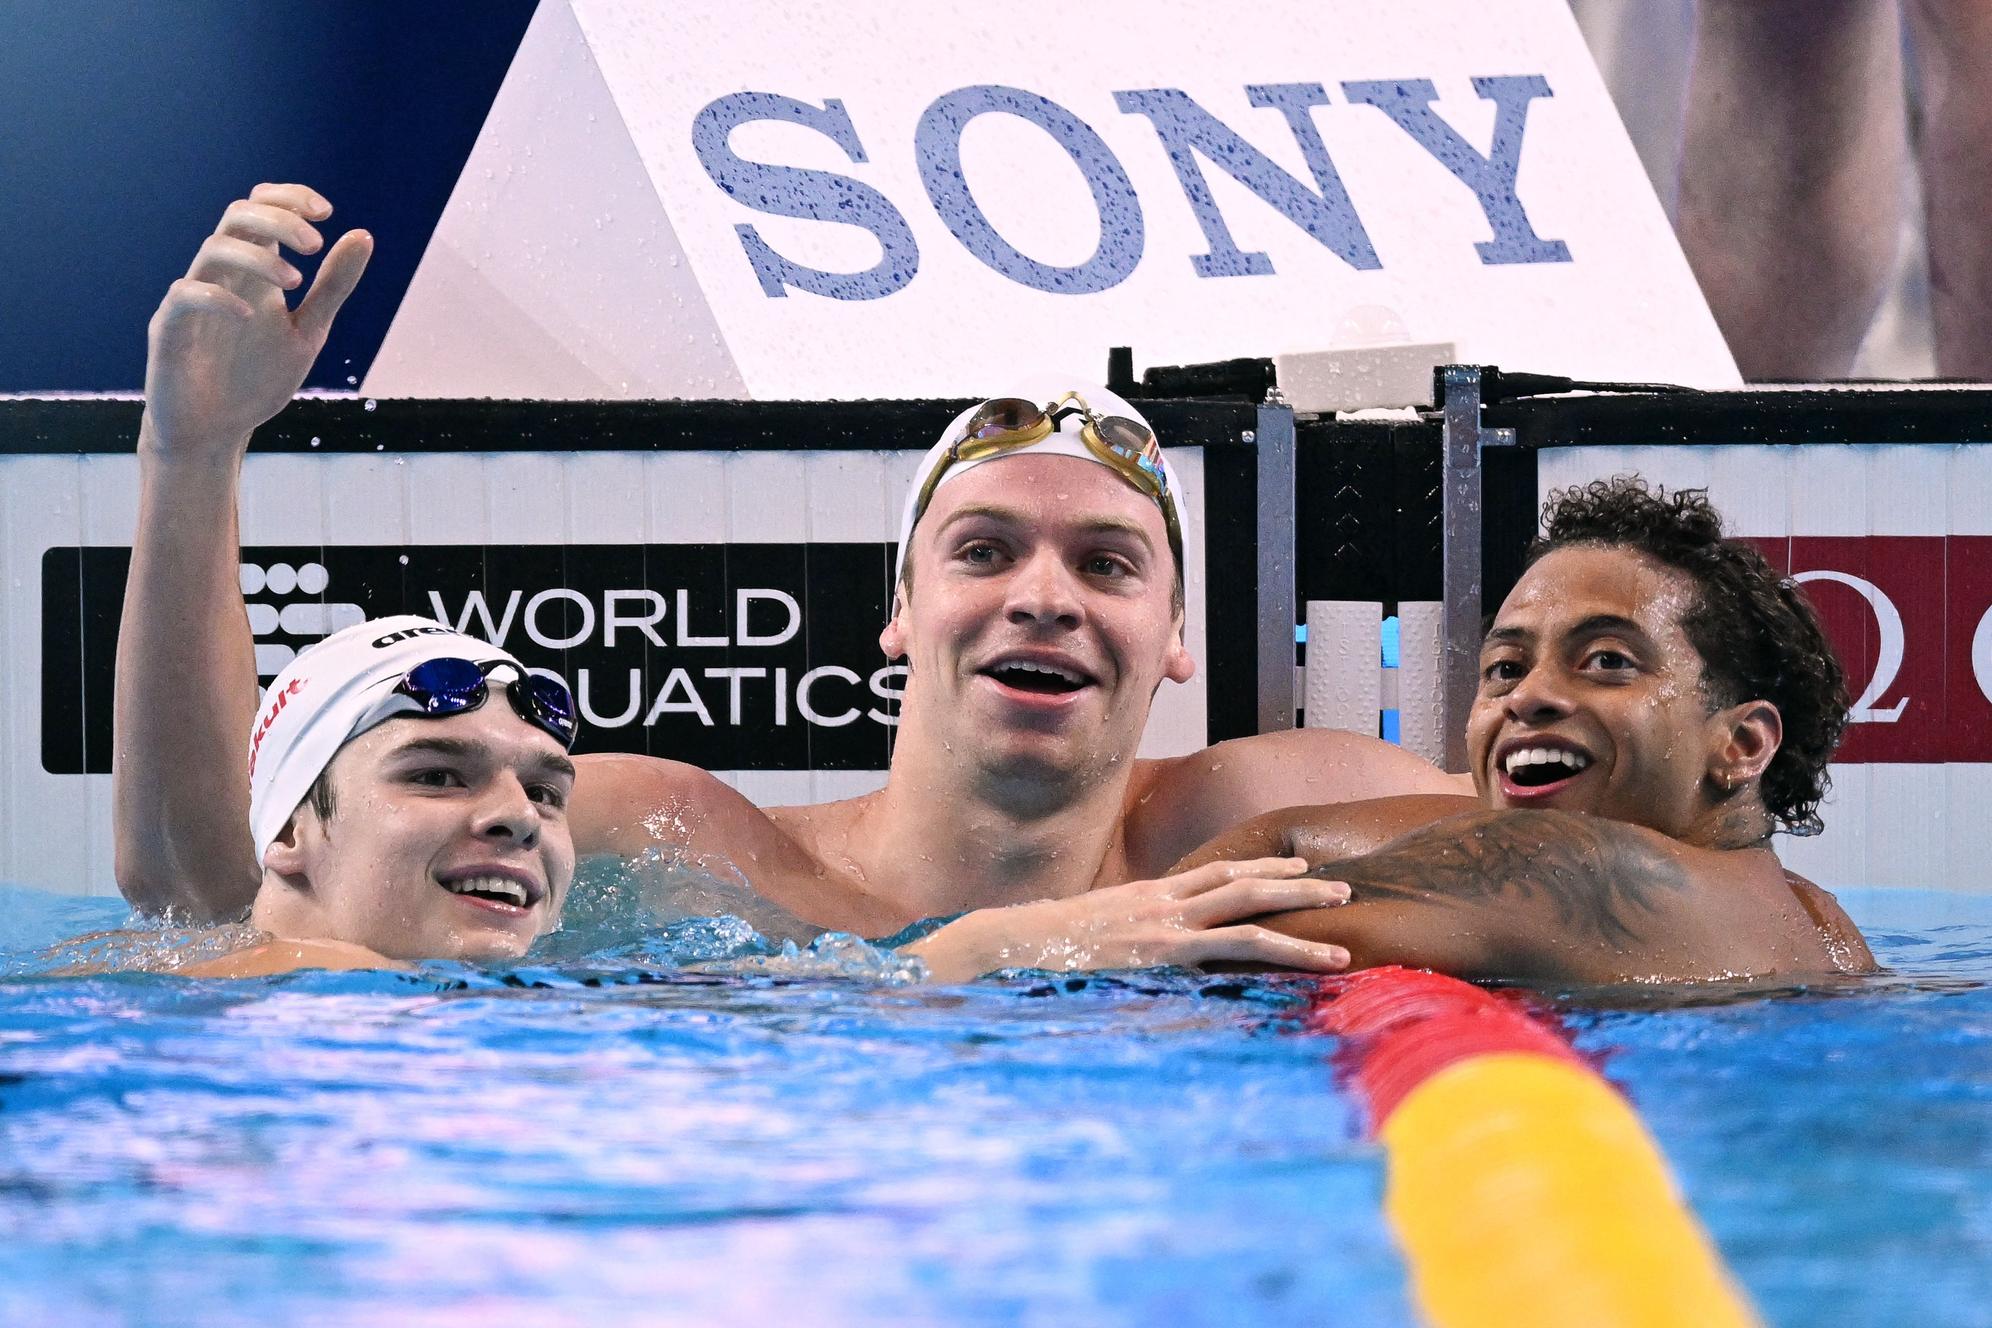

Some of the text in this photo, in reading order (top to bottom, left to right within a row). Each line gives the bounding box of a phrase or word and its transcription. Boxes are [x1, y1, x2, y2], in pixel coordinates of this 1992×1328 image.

[691, 74, 1573, 301] SONY
[372, 627, 458, 649] are
[428, 588, 801, 648] WORLD
[524, 666, 908, 727] UATICS
[249, 678, 306, 778] akult
